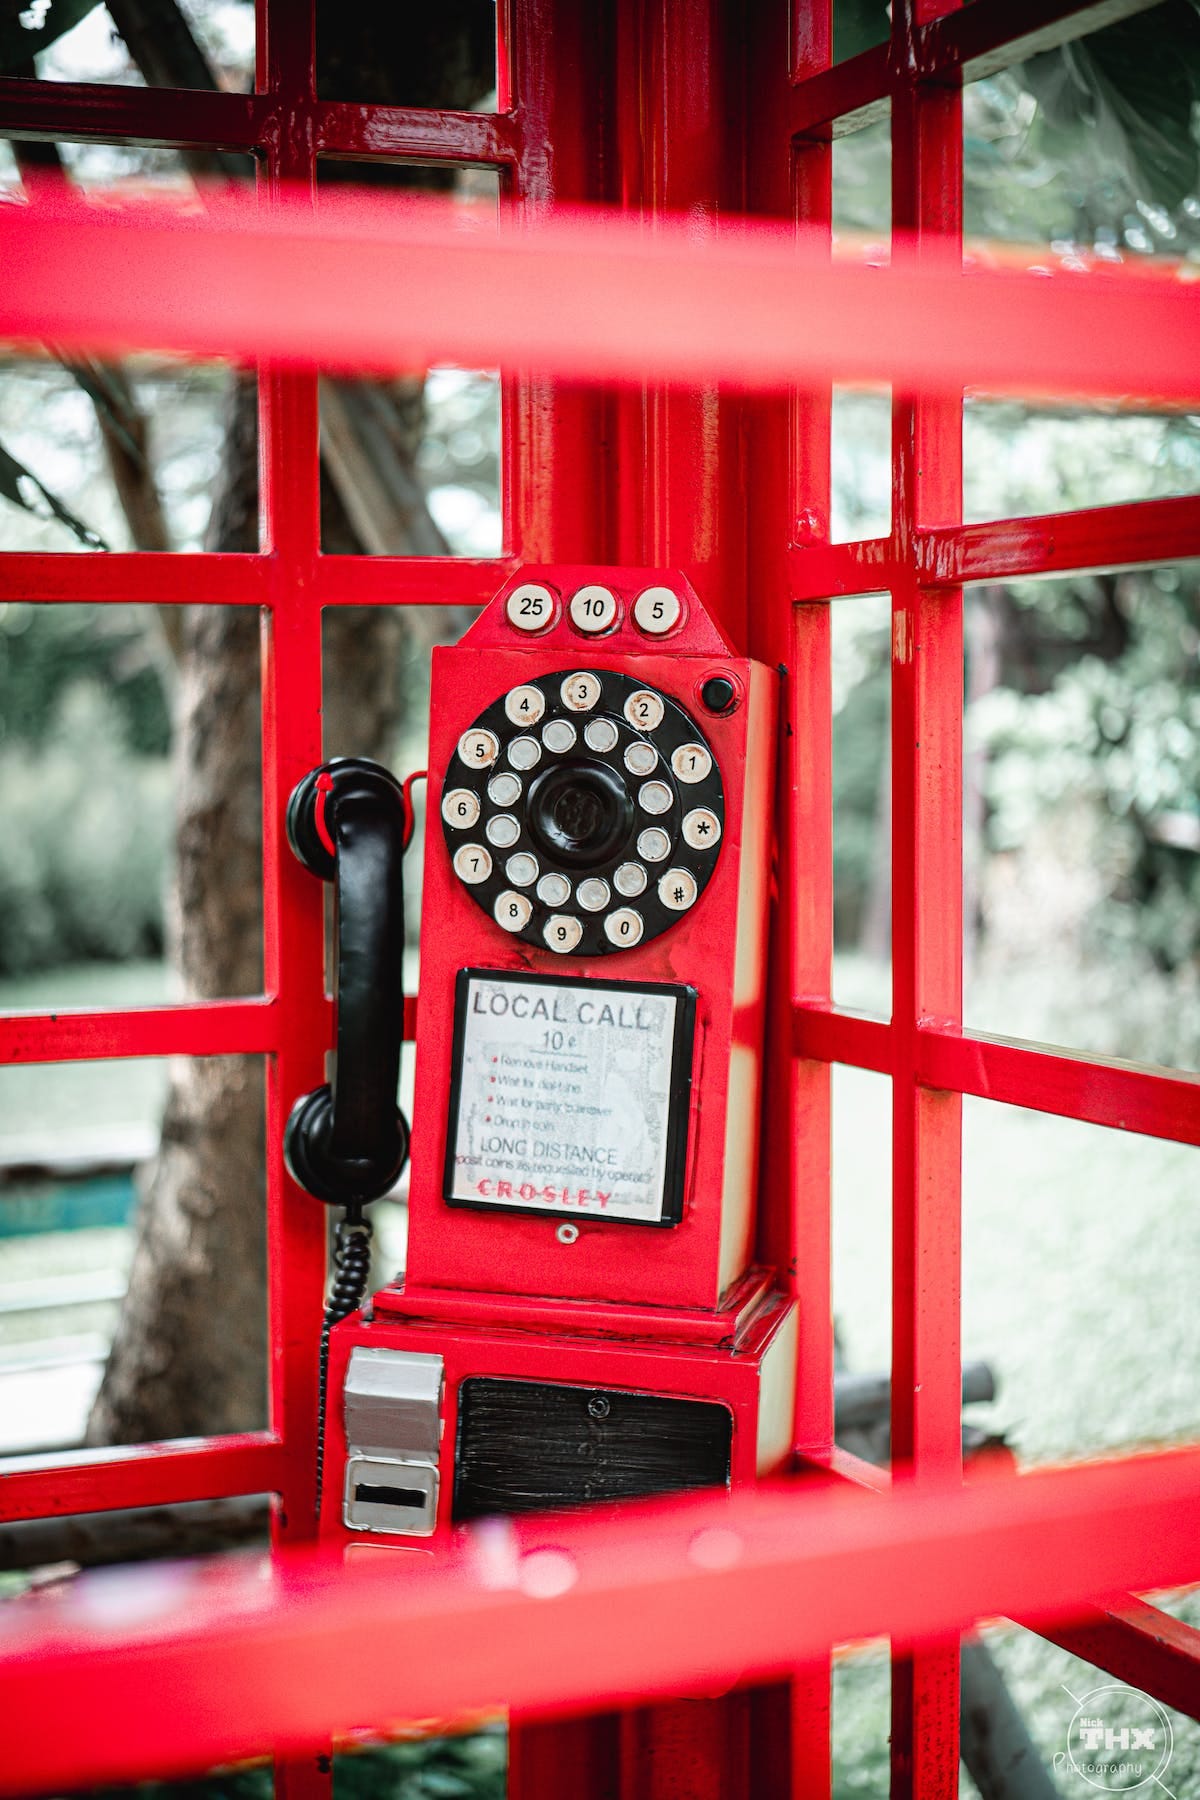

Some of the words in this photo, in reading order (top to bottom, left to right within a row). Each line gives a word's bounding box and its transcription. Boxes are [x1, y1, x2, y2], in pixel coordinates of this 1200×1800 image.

[520, 598, 543, 615] 25
[582, 599, 604, 617] 10
[652, 602, 664, 619] 5
[578, 685, 587, 699] 3
[519, 698, 529, 712] 4
[639, 703, 649, 717] 2
[475, 744, 485, 757] 5
[688, 756, 696, 770] 1
[457, 802, 467, 816] 6
[470, 859, 479, 873] 7
[674, 887, 684, 903] #
[509, 904, 518, 917] 8
[557, 926, 566, 940] 9
[620, 921, 629, 935] 0
[473, 991, 567, 1023] LOCAL
[577, 1002, 650, 1030] CALL
[480, 1136, 527, 1155] LONG
[533, 1140, 617, 1165] DISTANCE
[477, 1178, 612, 1209] CROSLEY
